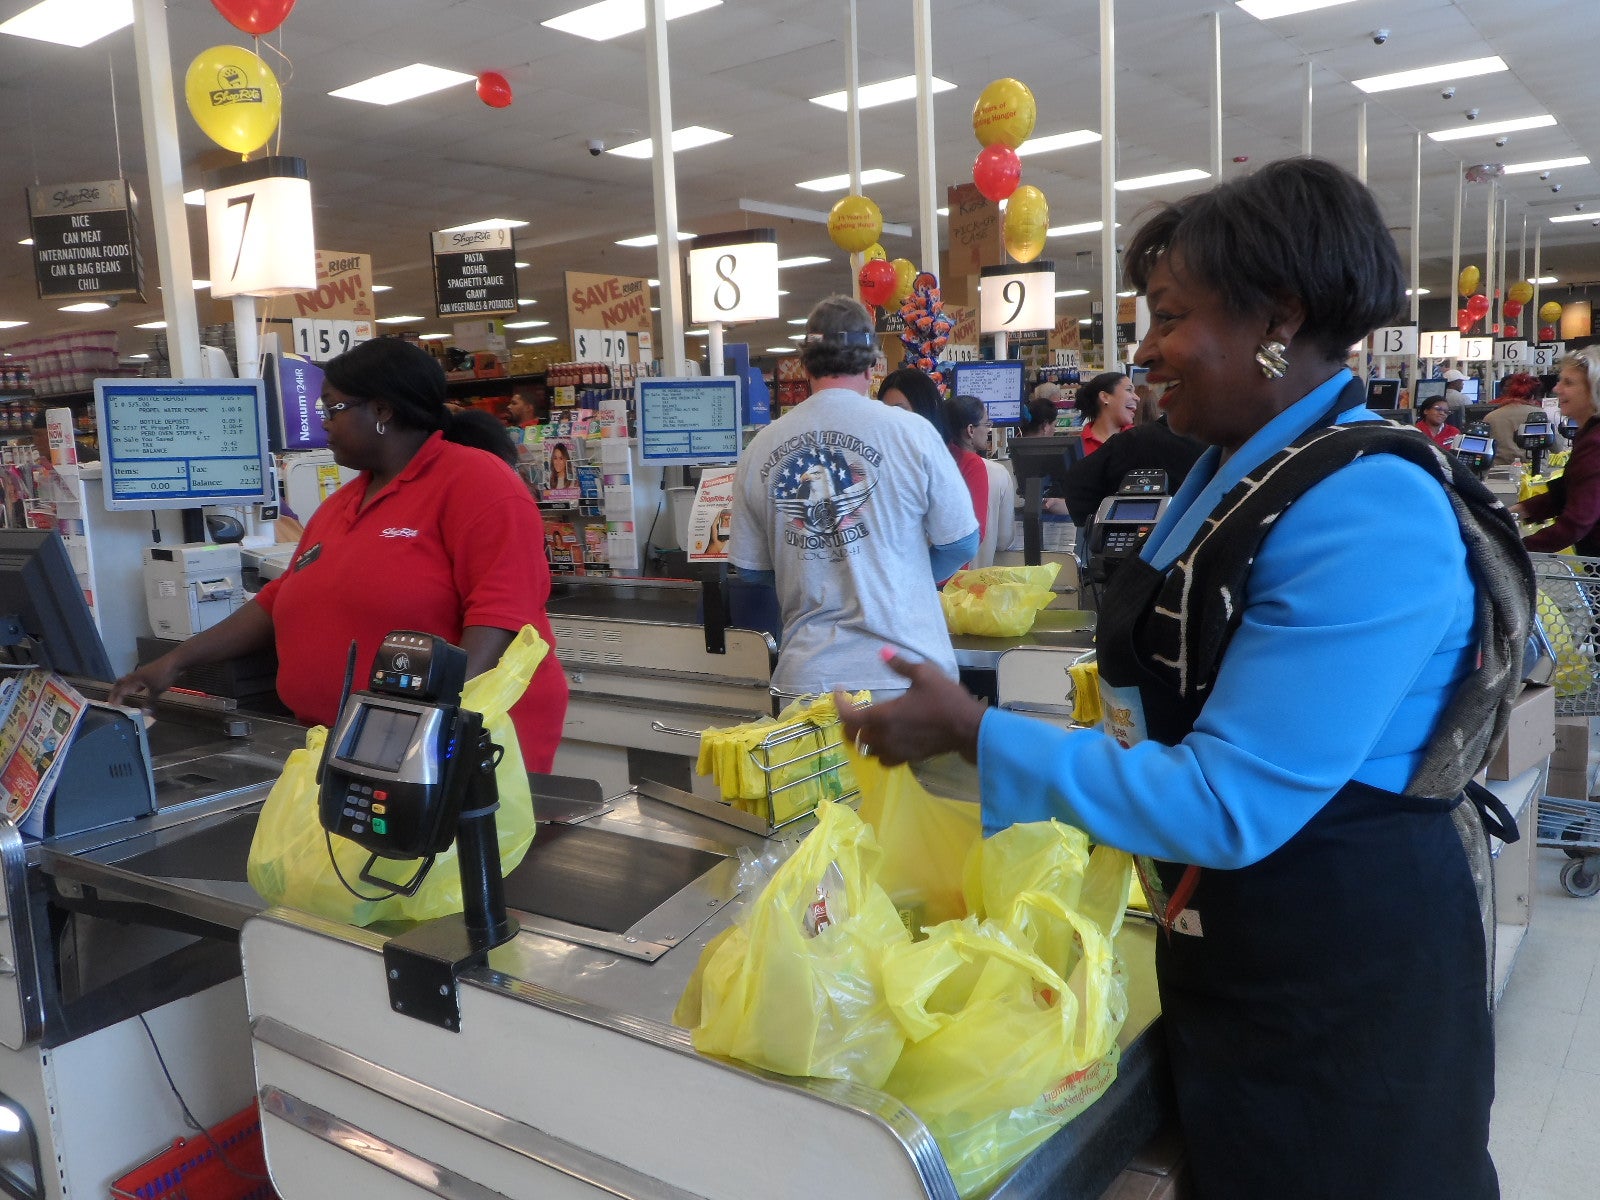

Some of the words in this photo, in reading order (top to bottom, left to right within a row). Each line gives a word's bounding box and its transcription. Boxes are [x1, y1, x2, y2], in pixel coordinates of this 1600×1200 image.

[213, 88, 260, 105] ShopRite
[992, 110, 1017, 122] Hunger
[52, 188, 100, 208] ShopRite
[71, 215, 90, 228] RICE
[62, 231, 79, 244] CAN
[81, 230, 101, 243] MEAT
[227, 193, 256, 282] 7
[452, 230, 491, 248] ShopRite
[39, 246, 102, 262] INTERNATIONAL
[103, 244, 129, 257] FOODS
[464, 252, 484, 263] PASTA
[50, 264, 67, 277] CAN
[68, 263, 75, 276] &
[77, 262, 94, 275] BAG
[95, 260, 121, 274] BEANS
[328, 256, 361, 273] RIGHT
[461, 264, 488, 275] KOSHER
[78, 278, 99, 291] CHILI
[447, 277, 482, 289] SPAGHETTI
[483, 275, 504, 286] SAUCE
[713, 254, 741, 311] 8
[293, 273, 367, 317] NOW!
[466, 288, 487, 299] GRAVY
[440, 303, 451, 313] CAN
[451, 301, 482, 312] VEGETABLES
[488, 298, 514, 310] POTATOES
[1002, 280, 1026, 326] 9
[601, 294, 647, 330] NOW!
[1384, 329, 1404, 352] 13
[1466, 340, 1482, 358] 15
[1502, 342, 1518, 360] 16
[299, 395, 310, 441] Nexium
[48, 430, 62, 439] NOW
[760, 431, 817, 482] AMERICAN
[820, 431, 882, 468] HERITAGE
[176, 466, 186, 474] 15
[191, 465, 207, 473] Tax:
[150, 482, 170, 490] 0.00
[1042, 1083, 1077, 1103] Fighting
